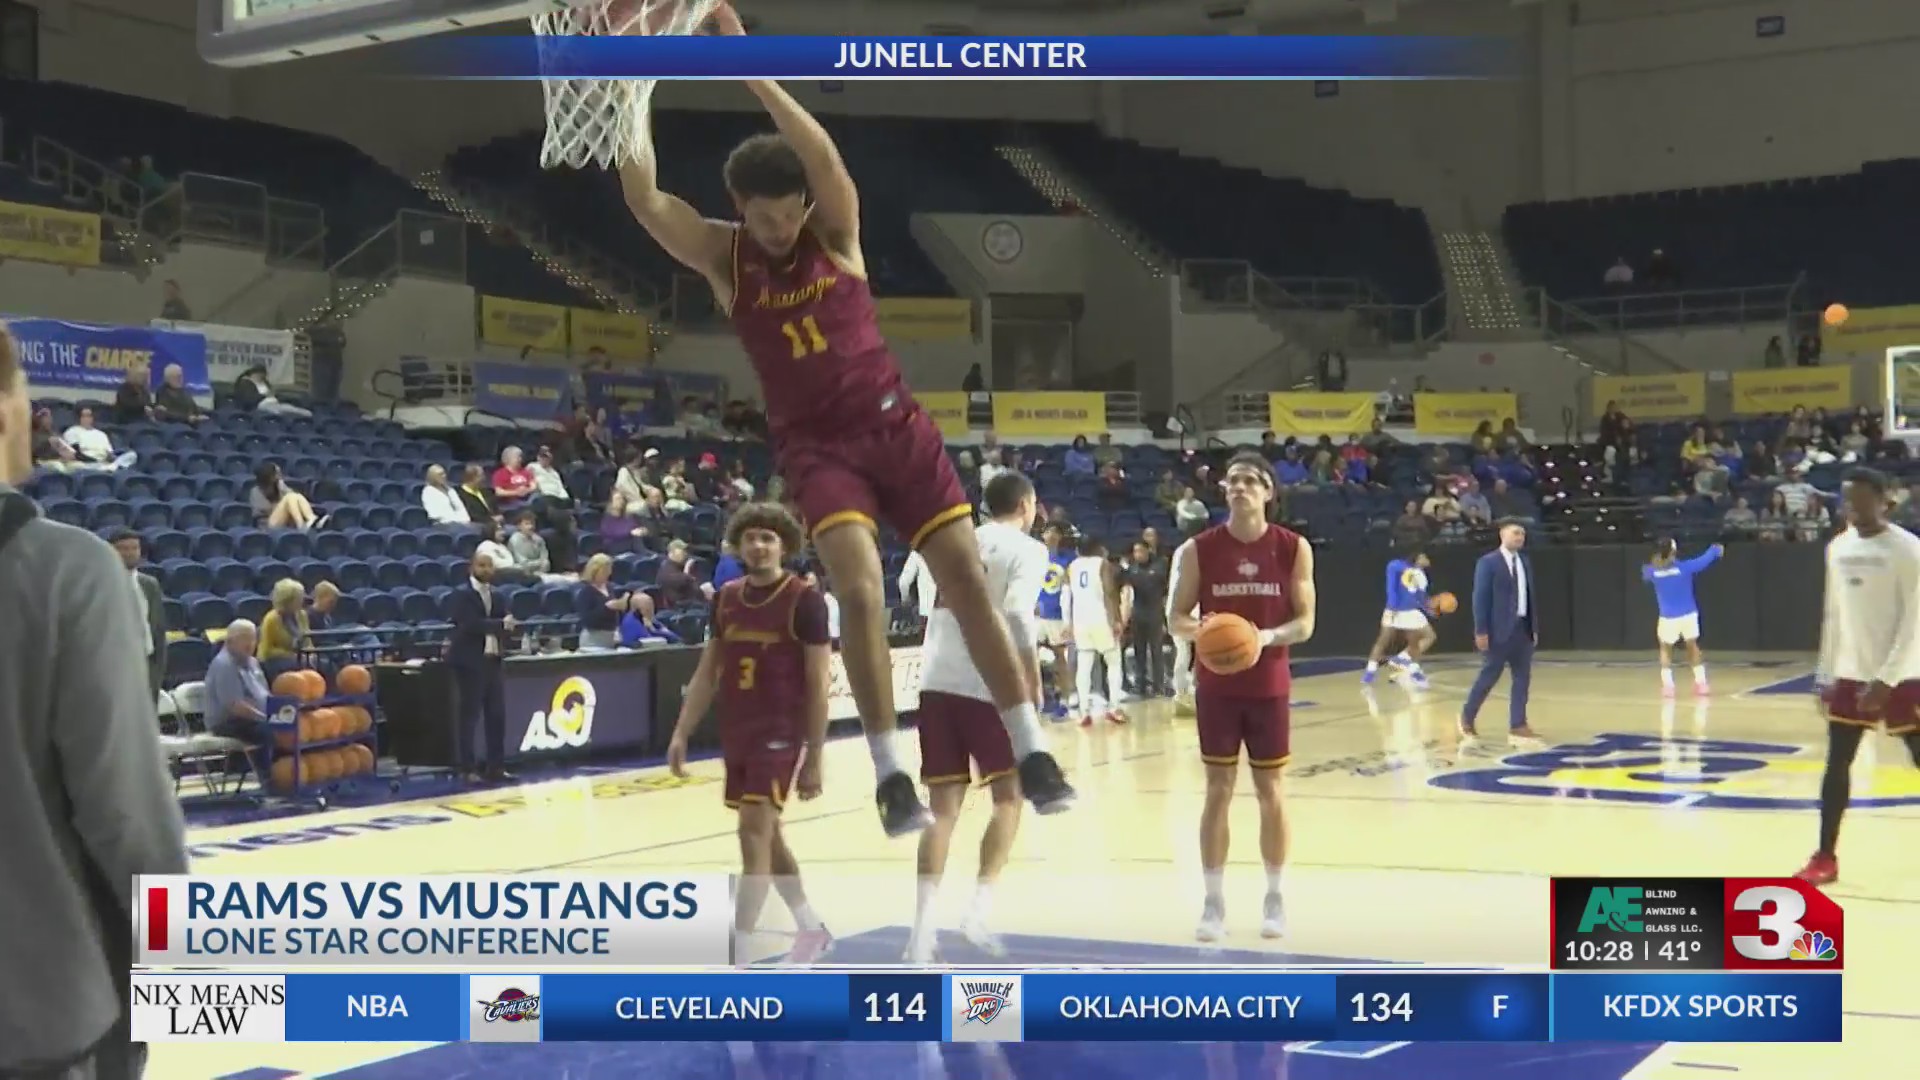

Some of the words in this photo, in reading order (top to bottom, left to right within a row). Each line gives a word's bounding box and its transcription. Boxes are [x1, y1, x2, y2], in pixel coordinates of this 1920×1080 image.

[781, 314, 828, 359] 11
[49, 342, 81, 368] THE
[1079, 570, 1089, 589] 0
[1211, 582, 1281, 598] BASKETBALL
[738, 656, 755, 690] 3
